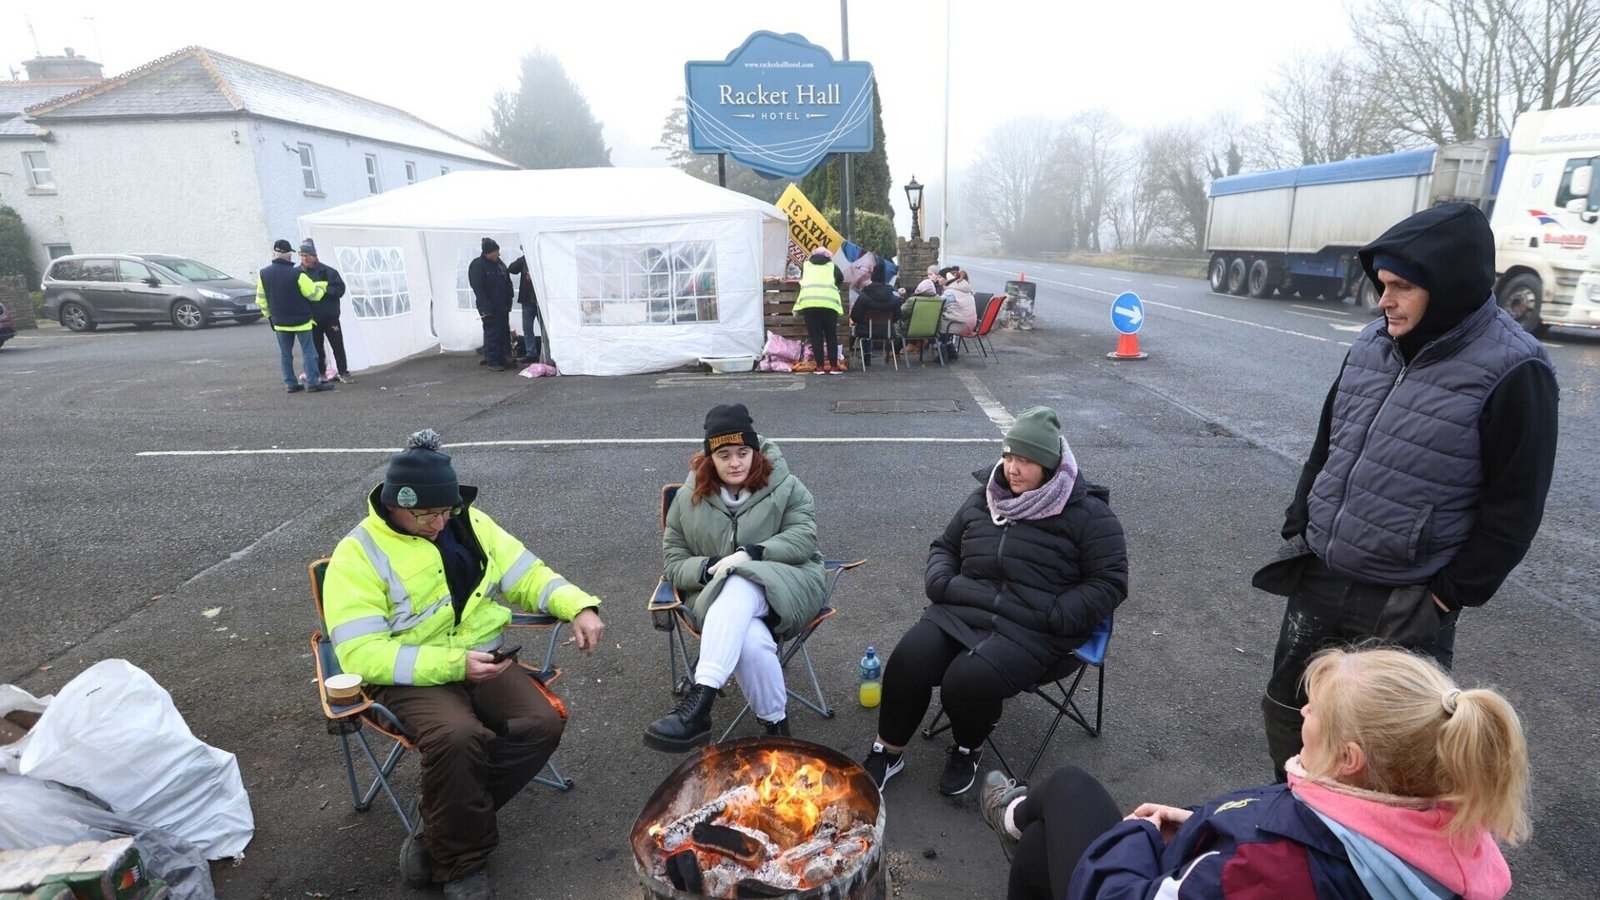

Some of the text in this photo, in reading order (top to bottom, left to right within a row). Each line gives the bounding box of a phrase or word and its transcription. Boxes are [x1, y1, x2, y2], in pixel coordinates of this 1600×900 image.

[719, 83, 841, 105] Racket Hall
[761, 112, 800, 120] HOTEL
[787, 198, 803, 217] 31
[800, 214, 833, 248] MAY
